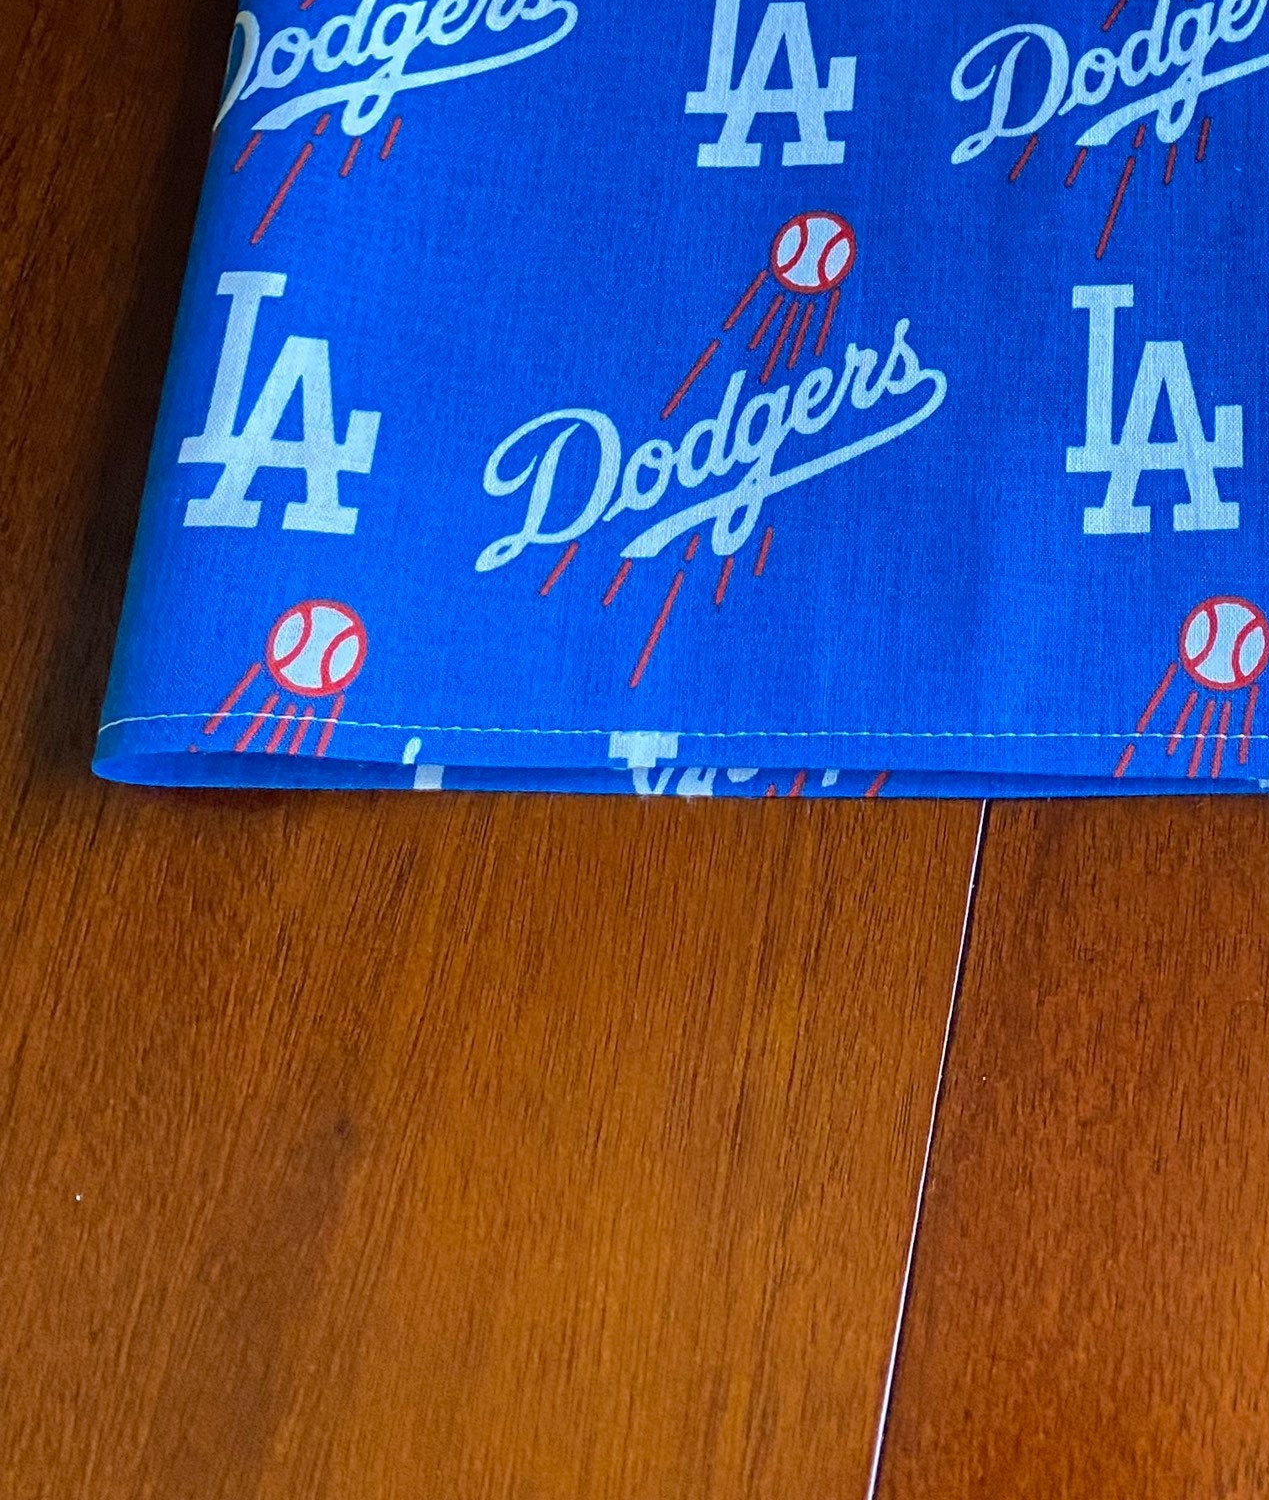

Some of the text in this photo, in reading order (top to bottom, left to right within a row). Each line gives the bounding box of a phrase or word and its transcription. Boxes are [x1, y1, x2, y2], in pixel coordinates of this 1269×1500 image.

[178, 271, 382, 535] LA
[475, 318, 949, 572] Dodgers
[1065, 284, 1244, 535] LA
